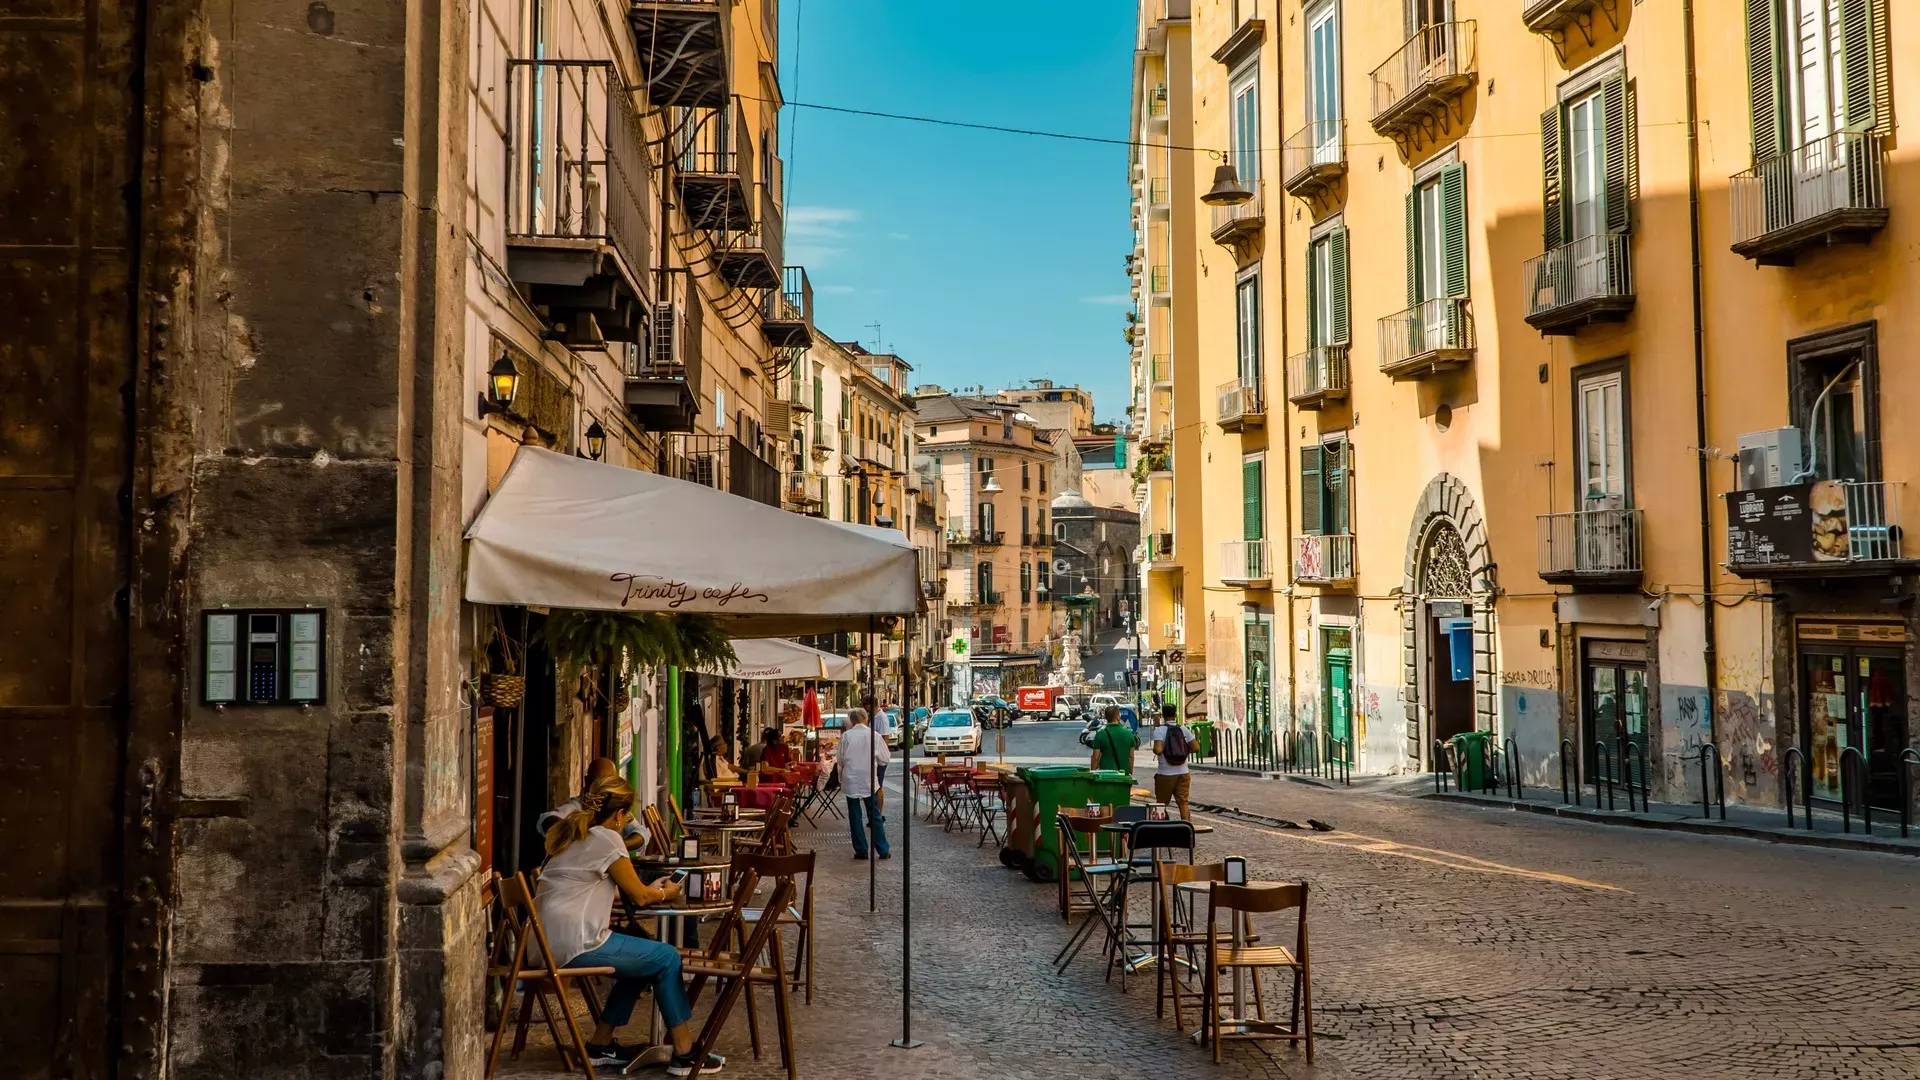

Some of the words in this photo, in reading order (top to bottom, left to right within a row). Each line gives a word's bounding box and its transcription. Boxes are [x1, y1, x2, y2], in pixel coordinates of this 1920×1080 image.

[1739, 502, 1765, 514] LUBRANO
[609, 572, 697, 608] Trinity
[732, 666, 782, 678] Lazzarella
